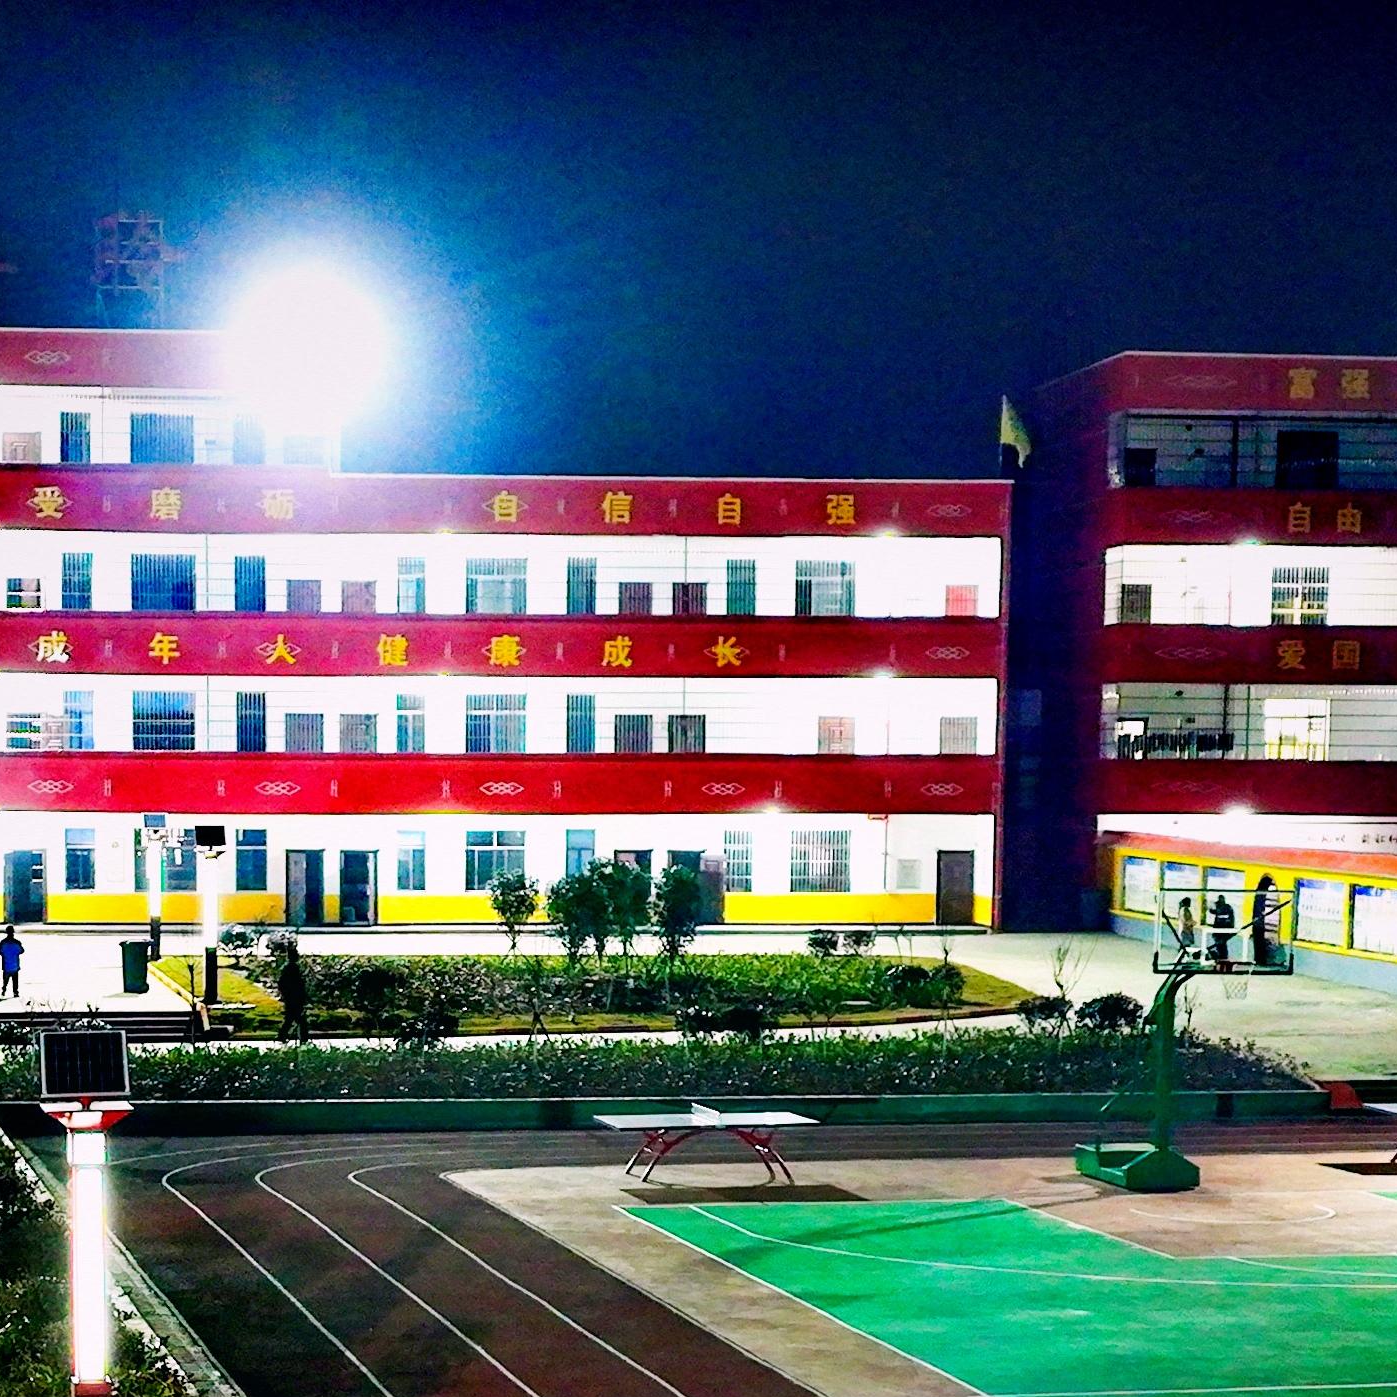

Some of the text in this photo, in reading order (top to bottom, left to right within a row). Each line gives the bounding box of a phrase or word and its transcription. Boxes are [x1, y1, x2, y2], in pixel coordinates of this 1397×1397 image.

[492, 489, 856, 526] 自信自强
[1288, 502, 1363, 534] 自由
